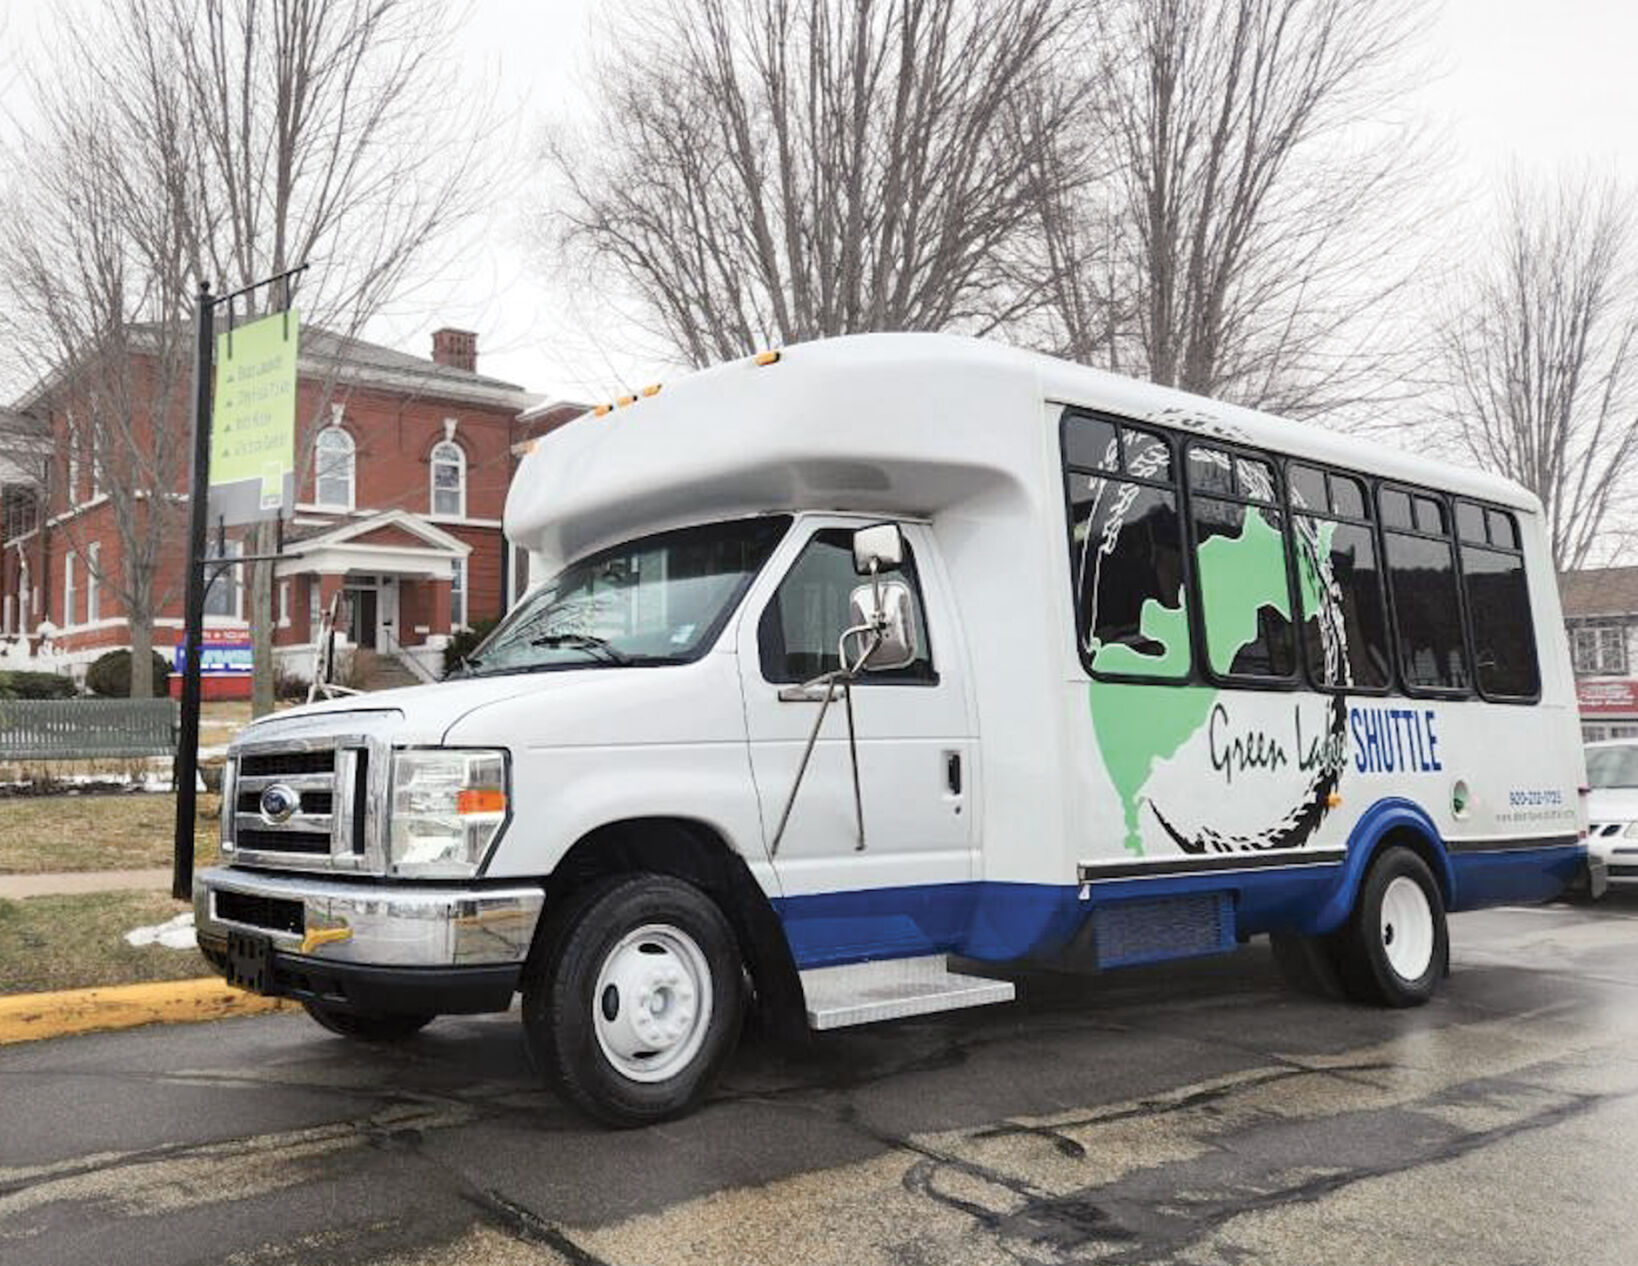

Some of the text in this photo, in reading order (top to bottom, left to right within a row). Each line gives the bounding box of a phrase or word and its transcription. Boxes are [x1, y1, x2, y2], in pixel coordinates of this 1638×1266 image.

[1209, 698, 1442, 784] Green Lake SHUTTLE
